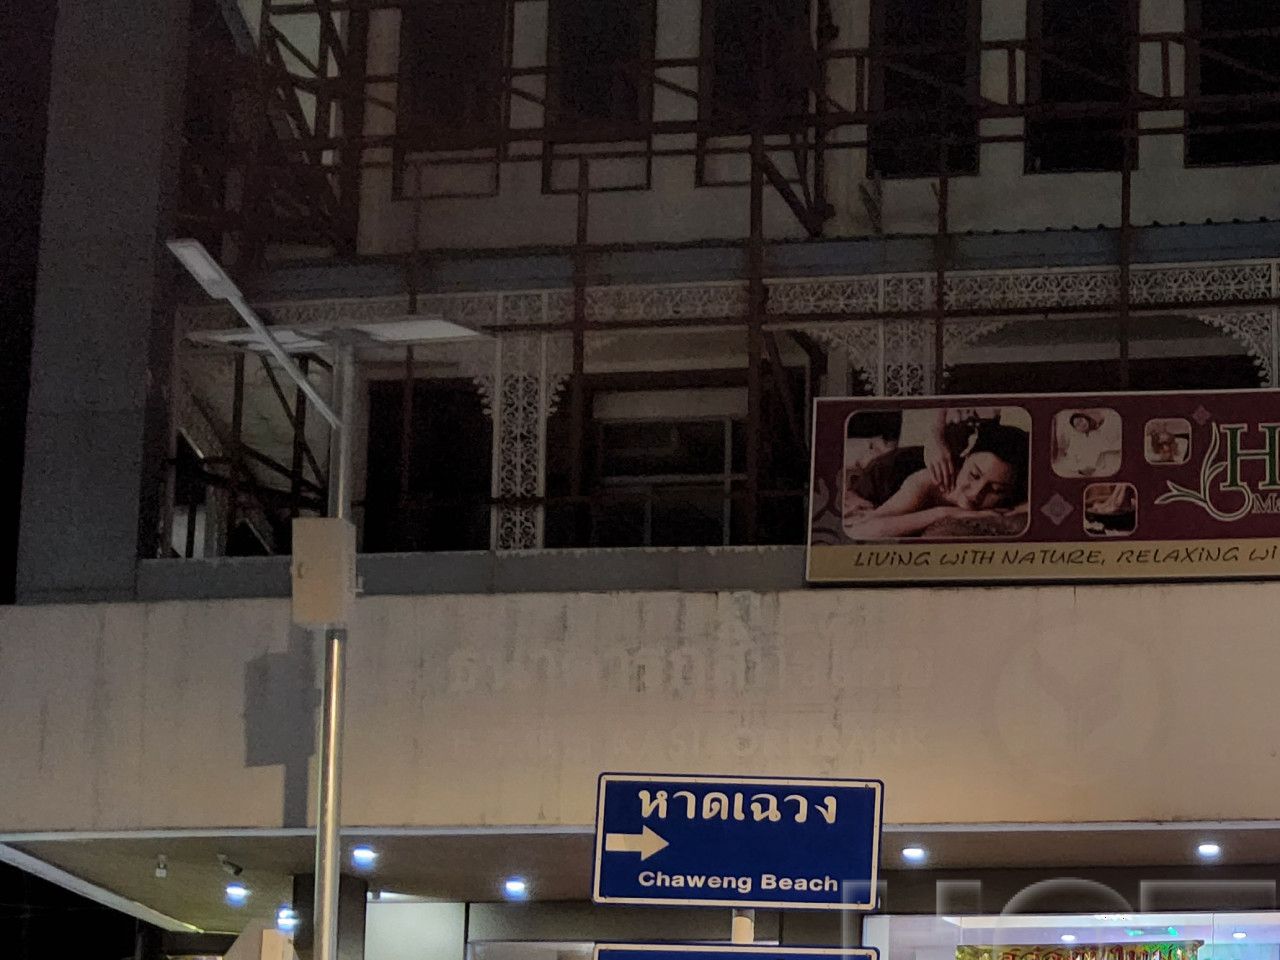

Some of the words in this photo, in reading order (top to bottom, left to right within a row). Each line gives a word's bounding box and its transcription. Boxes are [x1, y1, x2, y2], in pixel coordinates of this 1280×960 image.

[1001, 549, 1106, 566] NATURE,
[637, 789, 838, 824] หาดเฉวง
[637, 871, 753, 894] Chaweng
[760, 874, 838, 893] Beach
